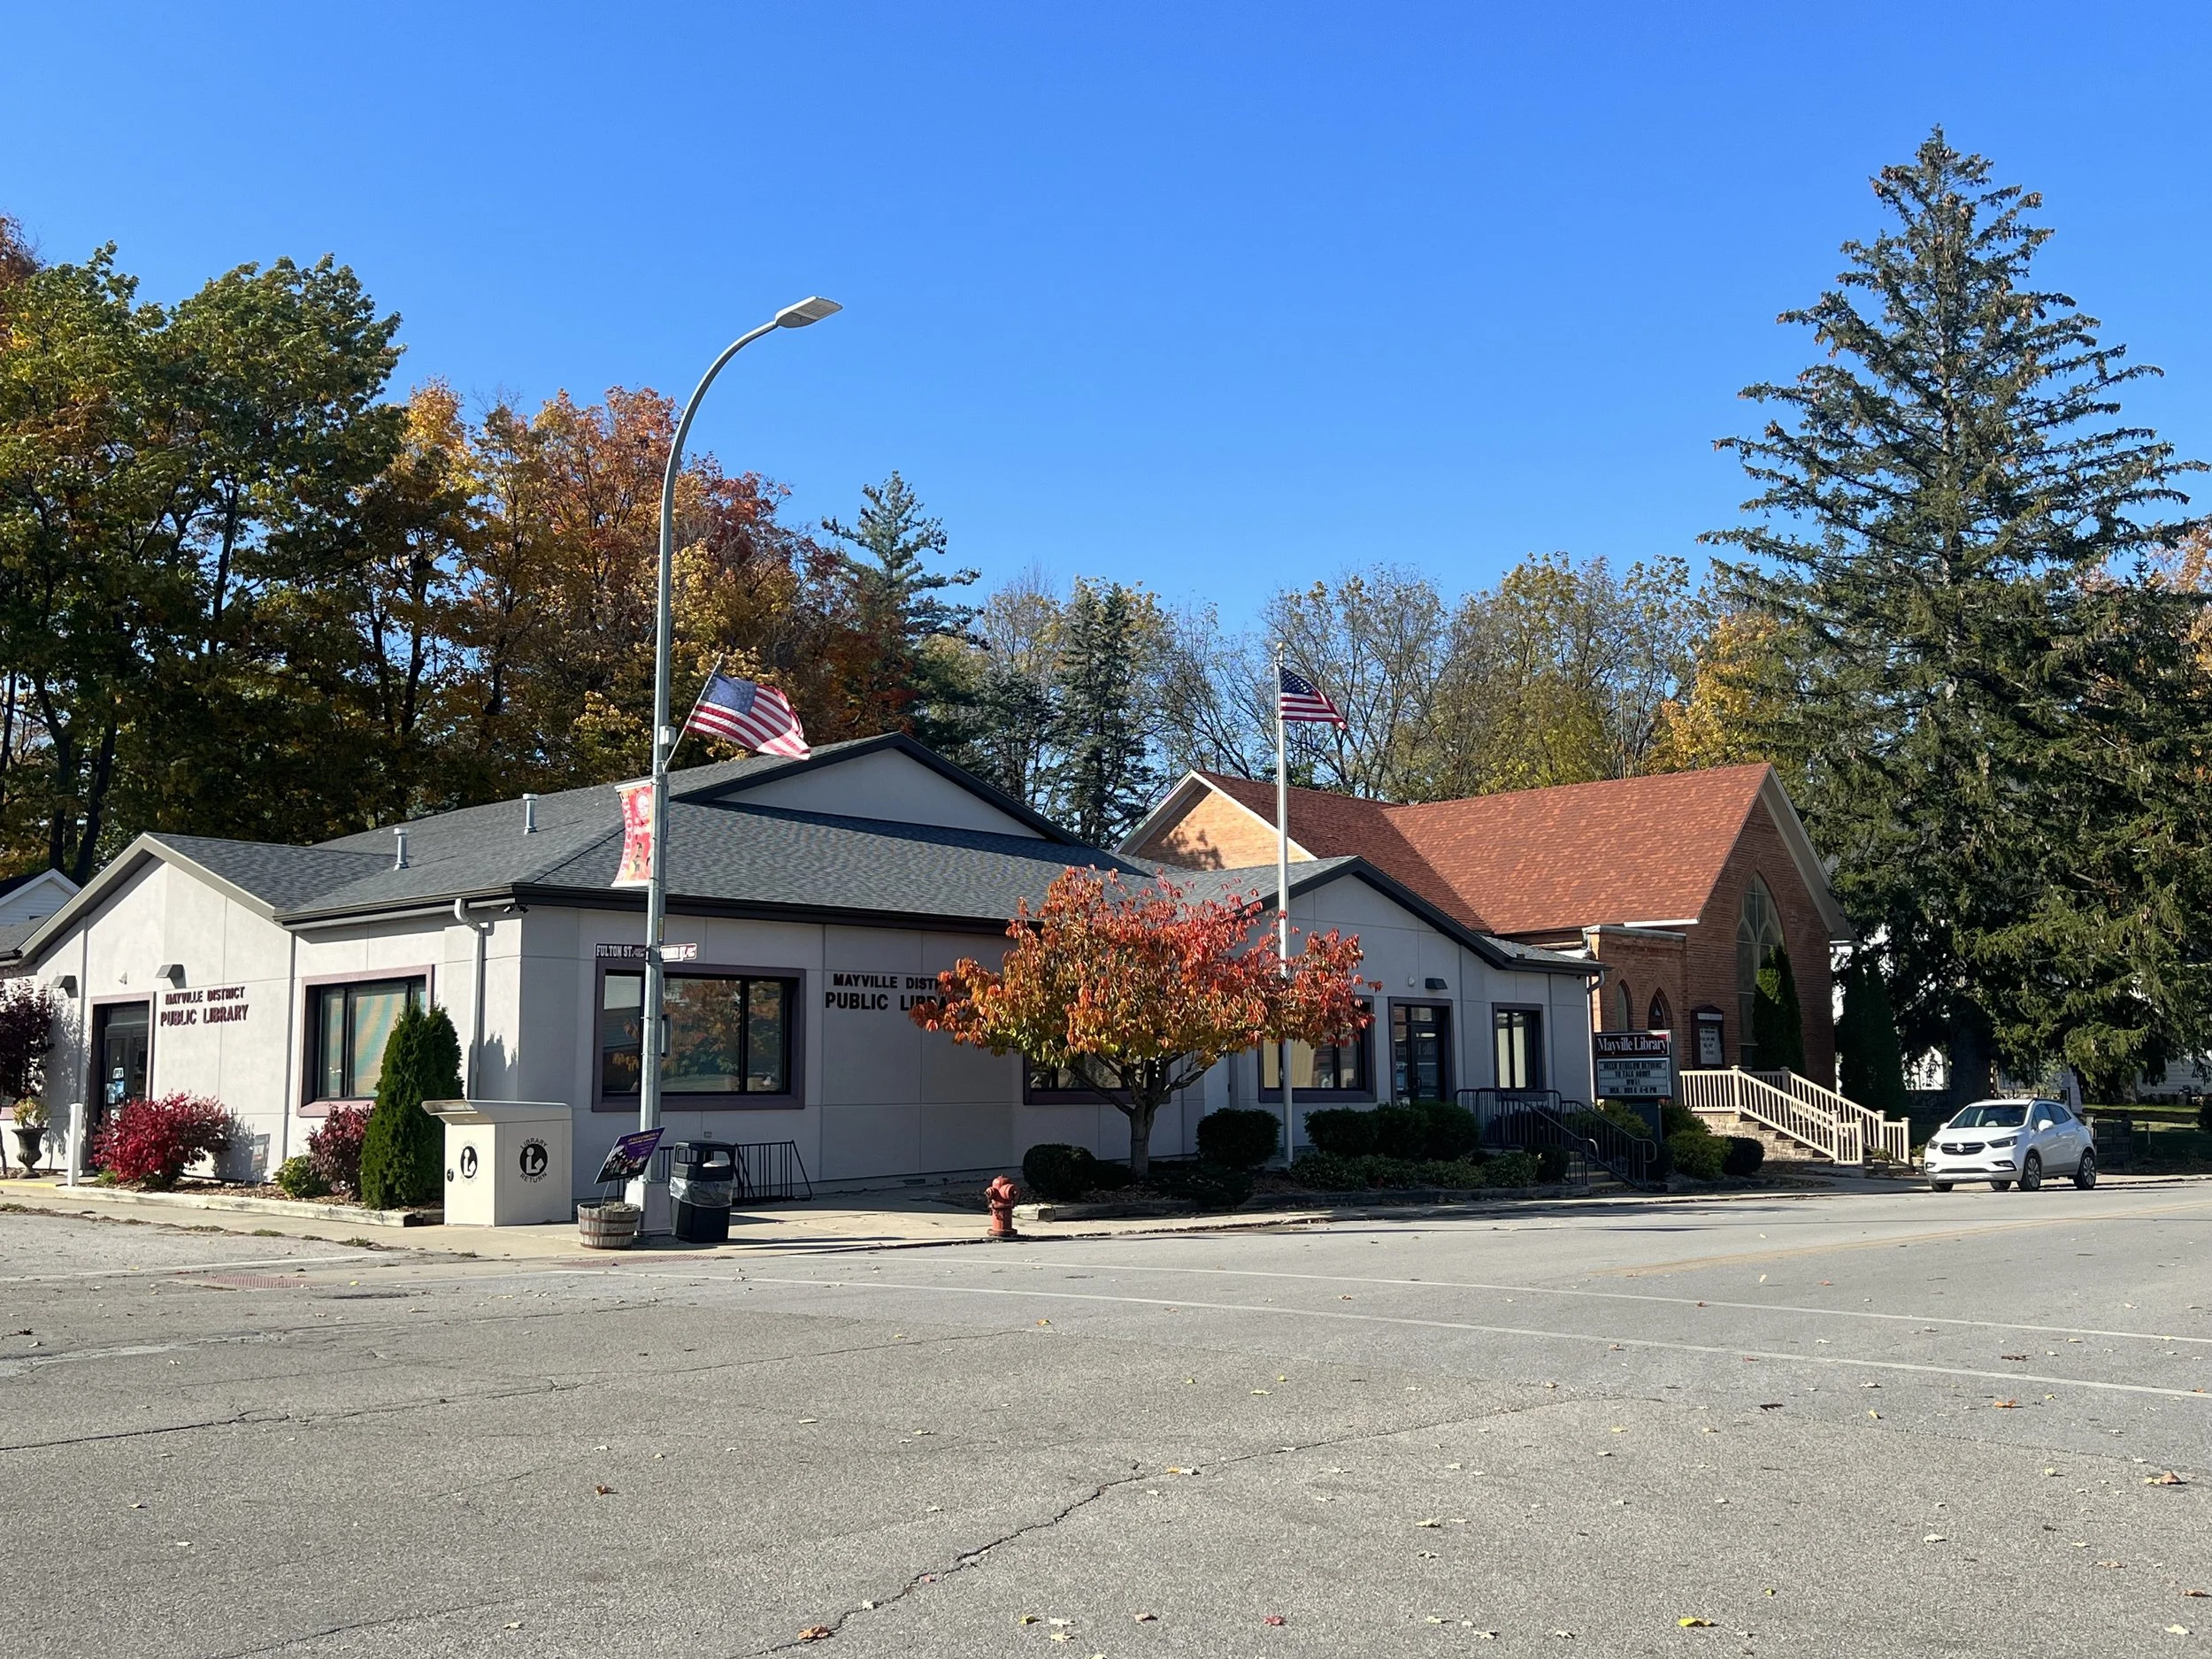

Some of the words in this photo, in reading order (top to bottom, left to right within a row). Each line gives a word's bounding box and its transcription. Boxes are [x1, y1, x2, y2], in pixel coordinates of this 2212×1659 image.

[595, 945, 623, 957] FULTON
[833, 973, 898, 989] MAYVILLE
[165, 990, 204, 1005] MAYVILLE
[207, 987, 245, 1002] DISTRICT
[826, 992, 888, 1010] PUBLIC
[160, 1009, 196, 1026] PUBLIC
[203, 1004, 249, 1024] LIBRARY
[1598, 1037, 1633, 1055] Mayville
[1634, 1036, 1666, 1054] Library
[520, 1138, 548, 1149] LIBRARY
[520, 1171, 547, 1183] RETURN
